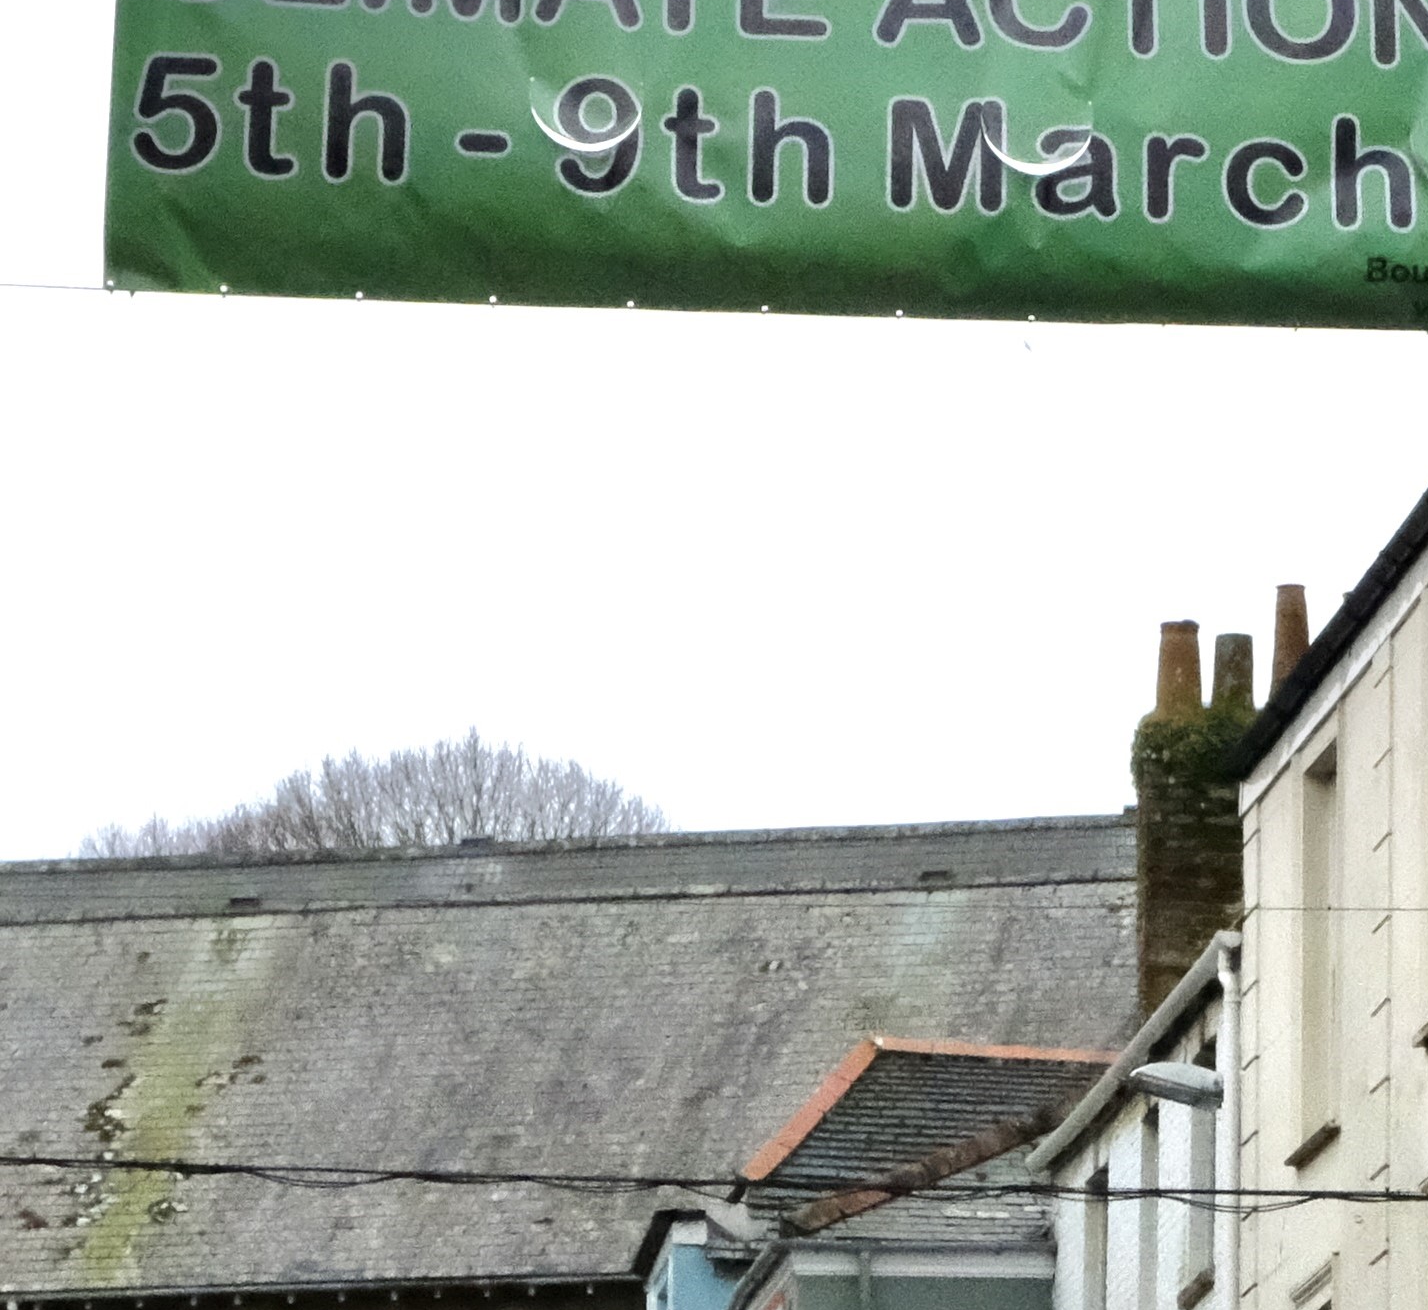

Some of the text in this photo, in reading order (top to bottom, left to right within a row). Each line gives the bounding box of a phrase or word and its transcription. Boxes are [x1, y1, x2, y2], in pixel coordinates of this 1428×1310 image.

[131, 52, 410, 183] 5th
[554, 74, 835, 209] 9th
[886, 95, 1417, 234] March
